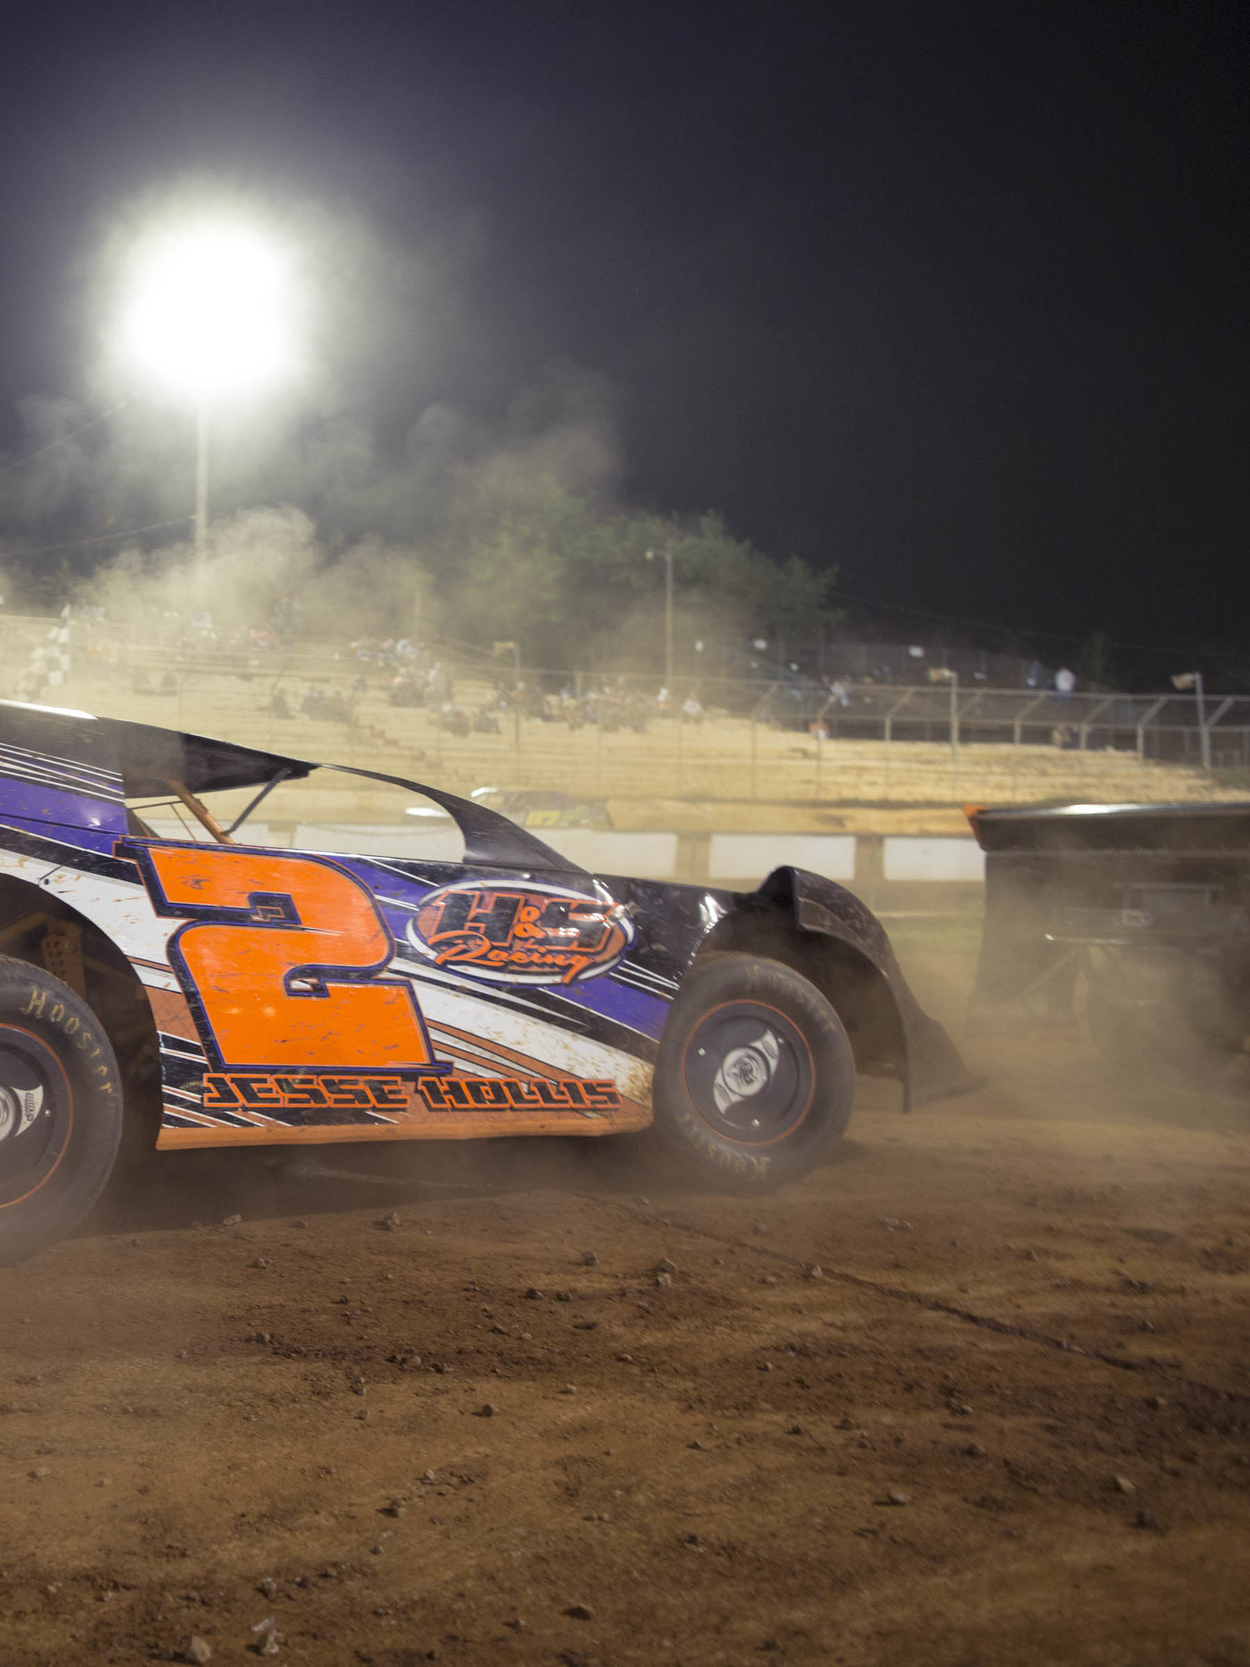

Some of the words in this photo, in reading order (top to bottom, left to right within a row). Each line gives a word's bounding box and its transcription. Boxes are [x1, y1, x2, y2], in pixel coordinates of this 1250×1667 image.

[111, 836, 454, 1075] 2
[427, 930, 594, 984] Racing
[202, 1073, 411, 1111] JESSE
[414, 1078, 623, 1113] HOLLIS
